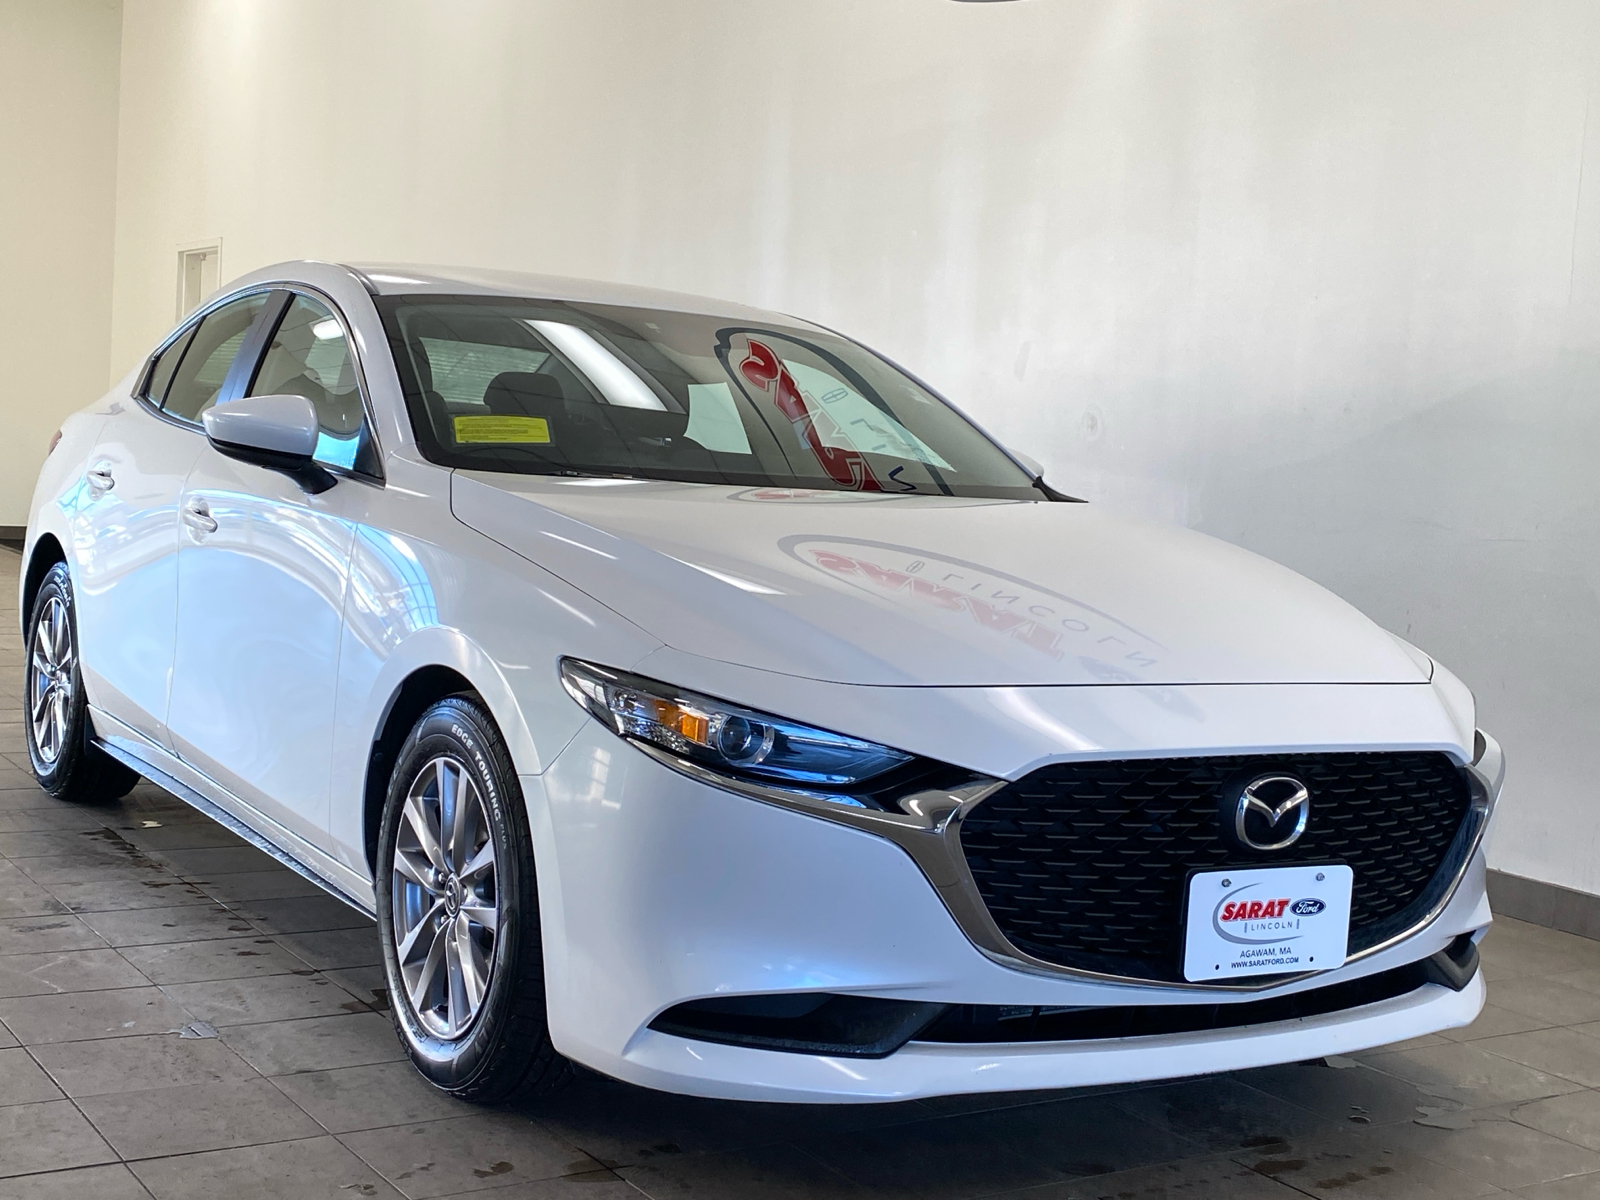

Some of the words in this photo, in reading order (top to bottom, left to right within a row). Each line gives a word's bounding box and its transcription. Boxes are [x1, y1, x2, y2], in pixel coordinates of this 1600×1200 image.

[451, 723, 474, 749] EDGE
[474, 751, 501, 822] TOURING
[1219, 898, 1292, 922] SARAT
[1295, 900, 1321, 914] Ford
[1251, 921, 1293, 931] LINCOLN
[1239, 947, 1278, 959] AGAWAM,
[1279, 946, 1292, 955] MA
[1230, 956, 1300, 969] WWW.SARATFORD.COM
